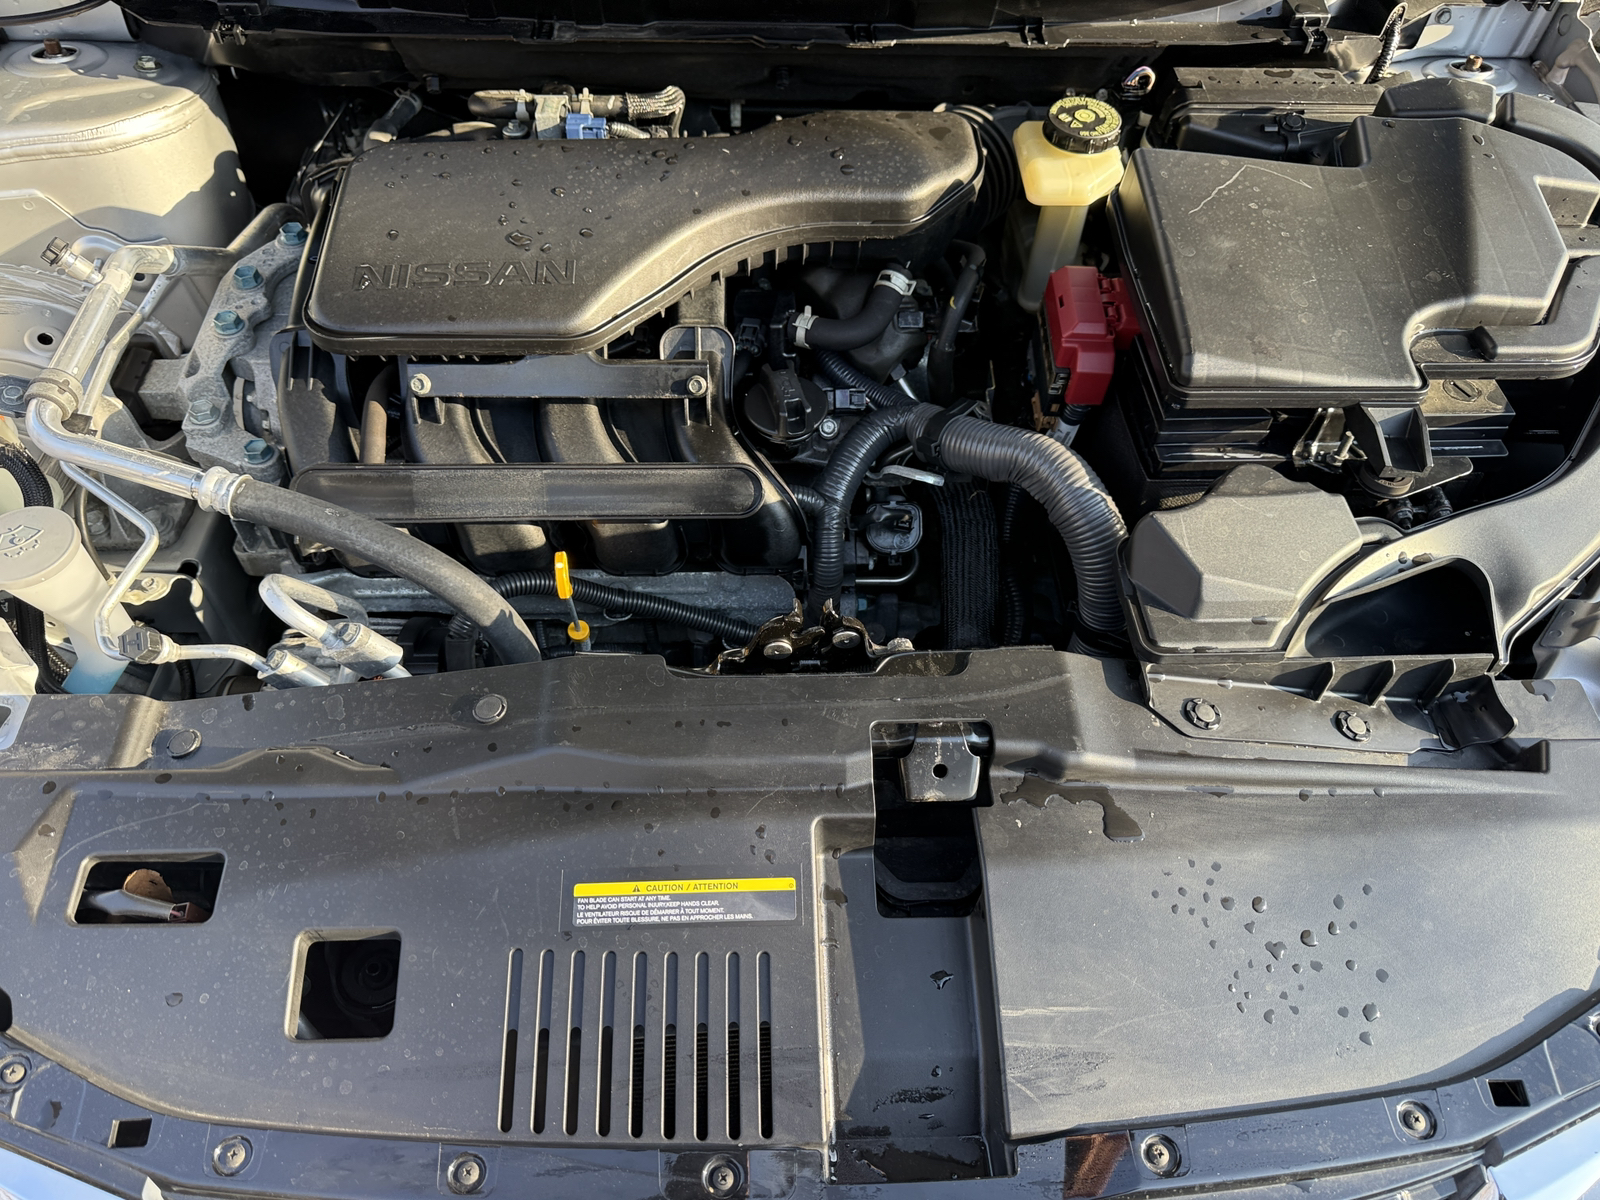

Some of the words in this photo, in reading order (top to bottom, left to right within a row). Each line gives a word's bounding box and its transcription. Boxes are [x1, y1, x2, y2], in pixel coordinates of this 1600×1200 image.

[352, 259, 577, 291] NISSAN
[646, 884, 684, 892] CAUTION
[692, 882, 738, 890] ATTENTION
